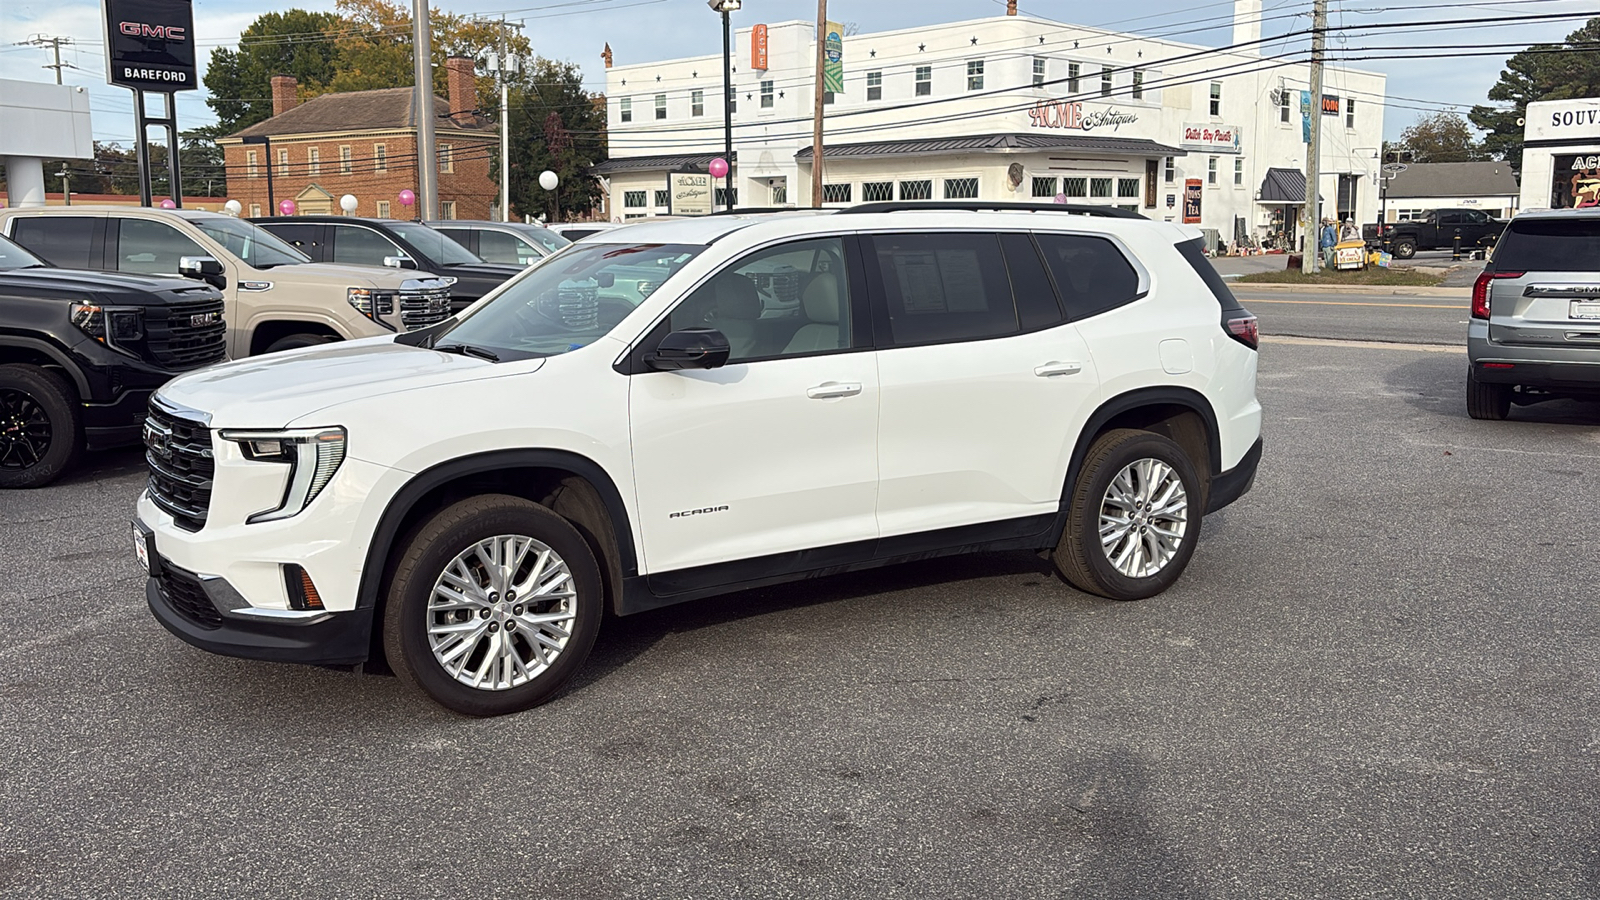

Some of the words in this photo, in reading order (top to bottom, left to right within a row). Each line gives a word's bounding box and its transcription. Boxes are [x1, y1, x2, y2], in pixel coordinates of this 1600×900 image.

[119, 21, 185, 40] GMC
[124, 67, 186, 82] BAREFORD
[1028, 99, 1082, 130] ACME
[1552, 109, 1600, 127] SOUV
[1185, 127, 1201, 140] Dutch
[1202, 128, 1213, 143] Boy
[1214, 129, 1231, 142] Paints
[1571, 156, 1600, 170] AC
[1188, 203, 1199, 215] TEA
[669, 505, 729, 519] ACADIA
